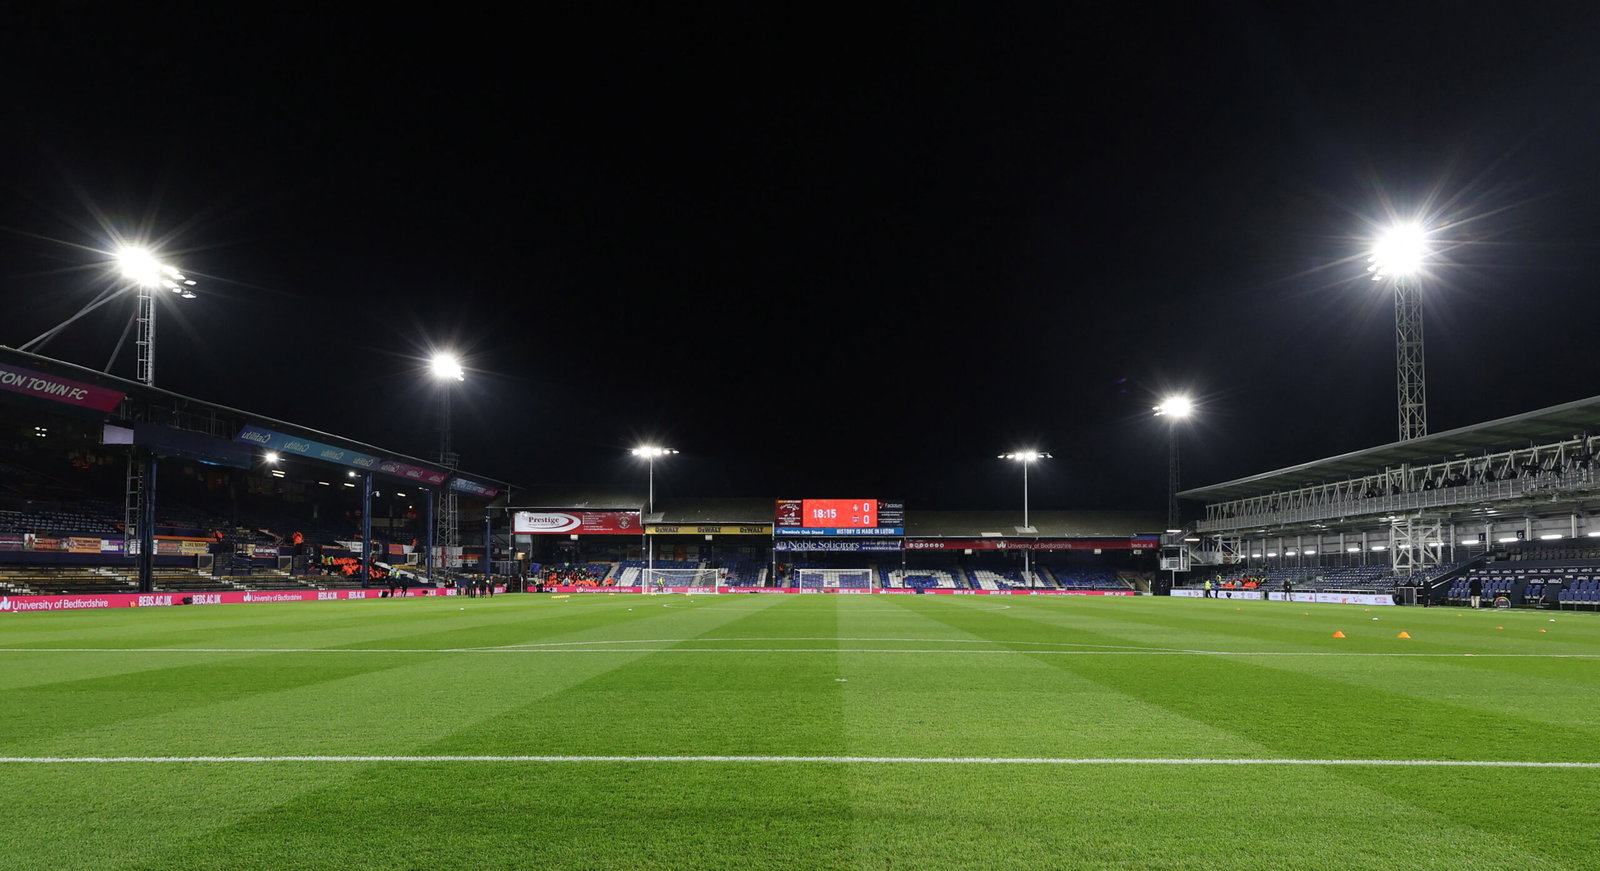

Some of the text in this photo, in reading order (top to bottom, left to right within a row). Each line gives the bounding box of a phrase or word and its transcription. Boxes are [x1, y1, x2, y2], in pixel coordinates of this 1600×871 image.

[27, 378, 70, 396] TOWN
[67, 387, 88, 400] FC
[863, 502, 870, 512] 0
[813, 509, 837, 518] 18:15
[528, 516, 560, 524] Prestige
[863, 515, 870, 524] 0
[788, 540, 817, 549] Noble
[818, 540, 860, 549] Solicitors
[12, 598, 109, 610] University of Bedfordshire
[138, 595, 172, 606] BEDS.AC.UK
[192, 594, 222, 604] BEDS.AC.UK
